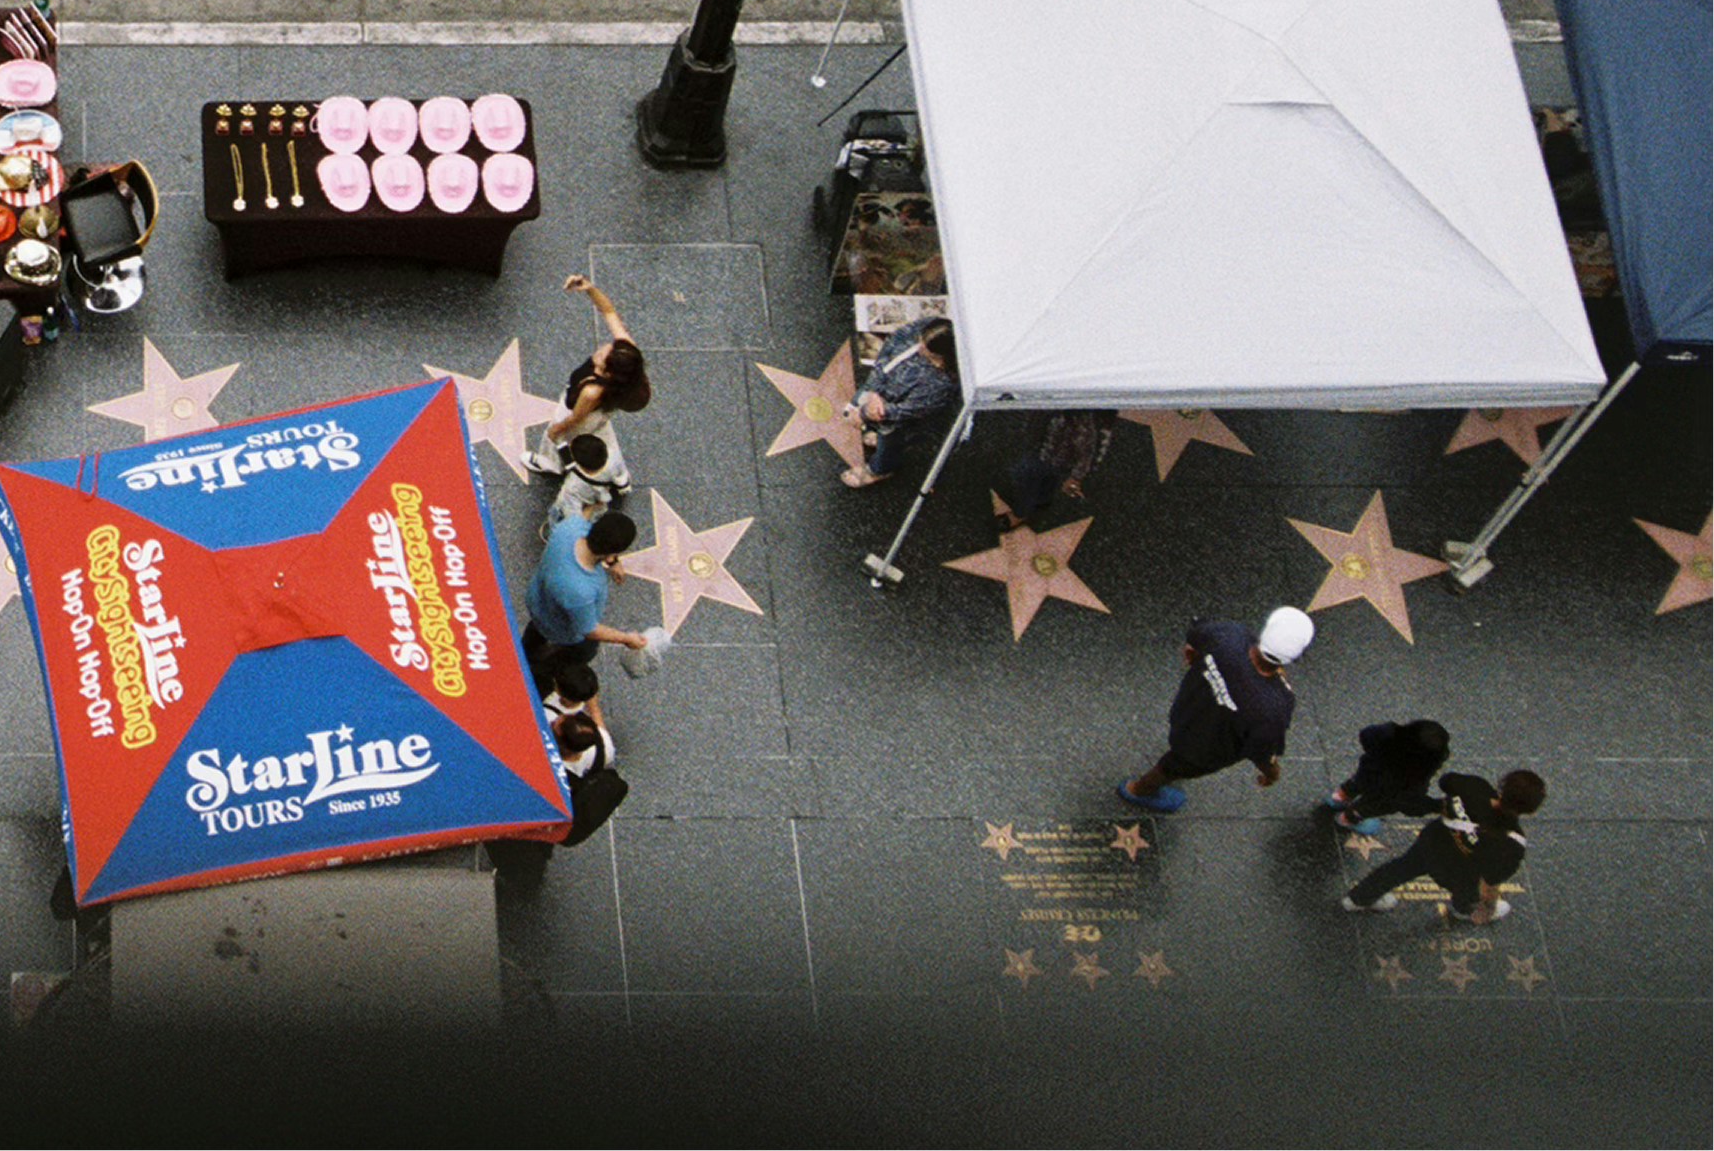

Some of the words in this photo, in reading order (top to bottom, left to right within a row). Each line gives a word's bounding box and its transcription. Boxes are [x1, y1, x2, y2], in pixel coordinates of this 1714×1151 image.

[118, 432, 361, 493] StarLine
[247, 420, 344, 448] TOURS
[428, 505, 469, 587] Hop-Off
[123, 539, 187, 709] StarLine
[365, 508, 429, 671] StarLine
[61, 568, 94, 650] Hop-On
[78, 651, 115, 737] Hop-Off
[454, 592, 491, 670] Hop-On
[186, 723, 441, 811] StarLine
[200, 796, 304, 836] TOURS
[328, 799, 366, 815] Since
[370, 791, 401, 809] 1935
